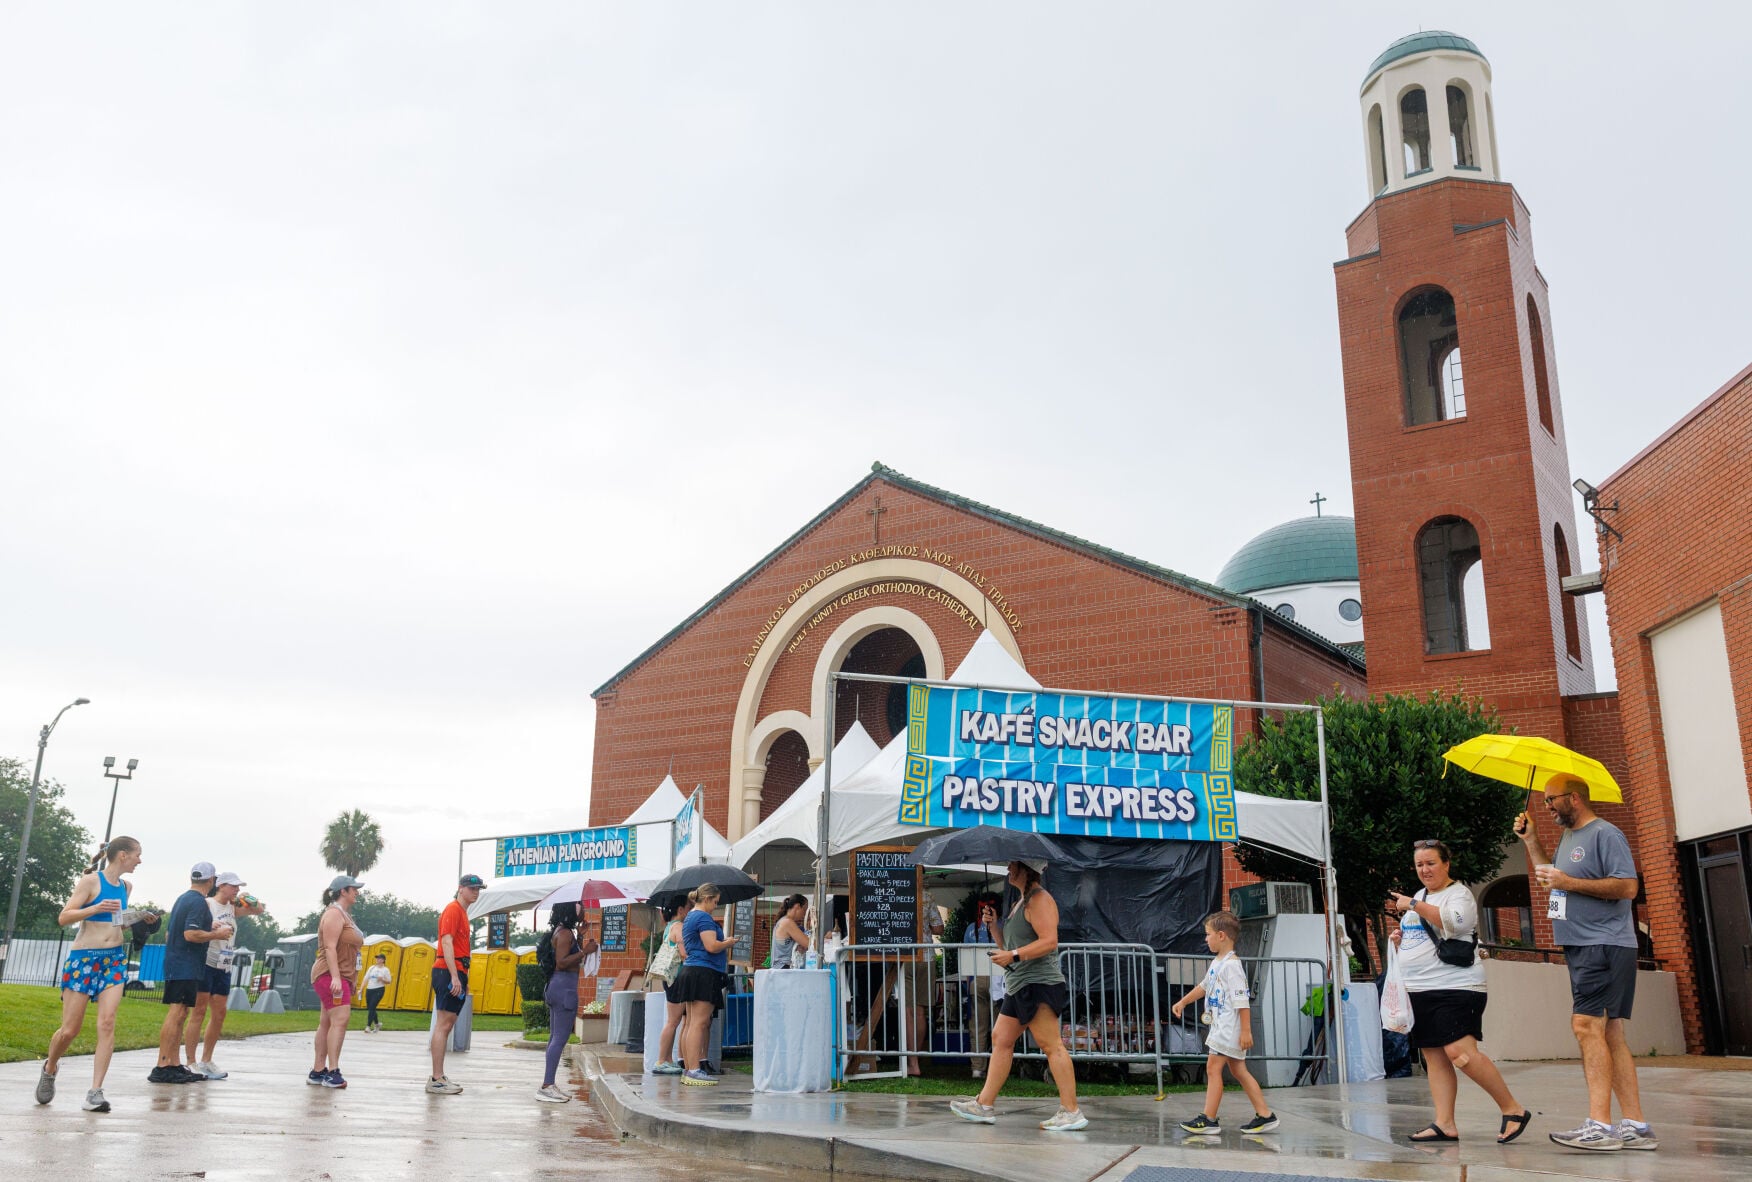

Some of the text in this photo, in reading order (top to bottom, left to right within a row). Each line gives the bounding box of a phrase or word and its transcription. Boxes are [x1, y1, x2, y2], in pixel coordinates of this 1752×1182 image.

[743, 545, 1023, 668] ΕΛΛΗΝΙΚΟΣ ΟΡΘΟΔΟΞΟΣ ΚΑΘΕΔΡΙΚΟΣ ΝΑΟΣ ΑΓΙΑΣ ΤΡΙΑΔΟΣ
[840, 587, 870, 606] GREEK
[871, 582, 927, 597] ORTHODOX
[927, 588, 979, 630] CATHEDRAL
[960, 706, 1193, 755] KAFÉ SNACK BAR
[942, 775, 1196, 823] PASTRY EXPRESS
[506, 839, 625, 866] ATHENIAN PLAYGROUND
[856, 853, 915, 867] PASTRY EXPR
[890, 912, 914, 920] PASTRY
[1549, 900, 1559, 912] 88
